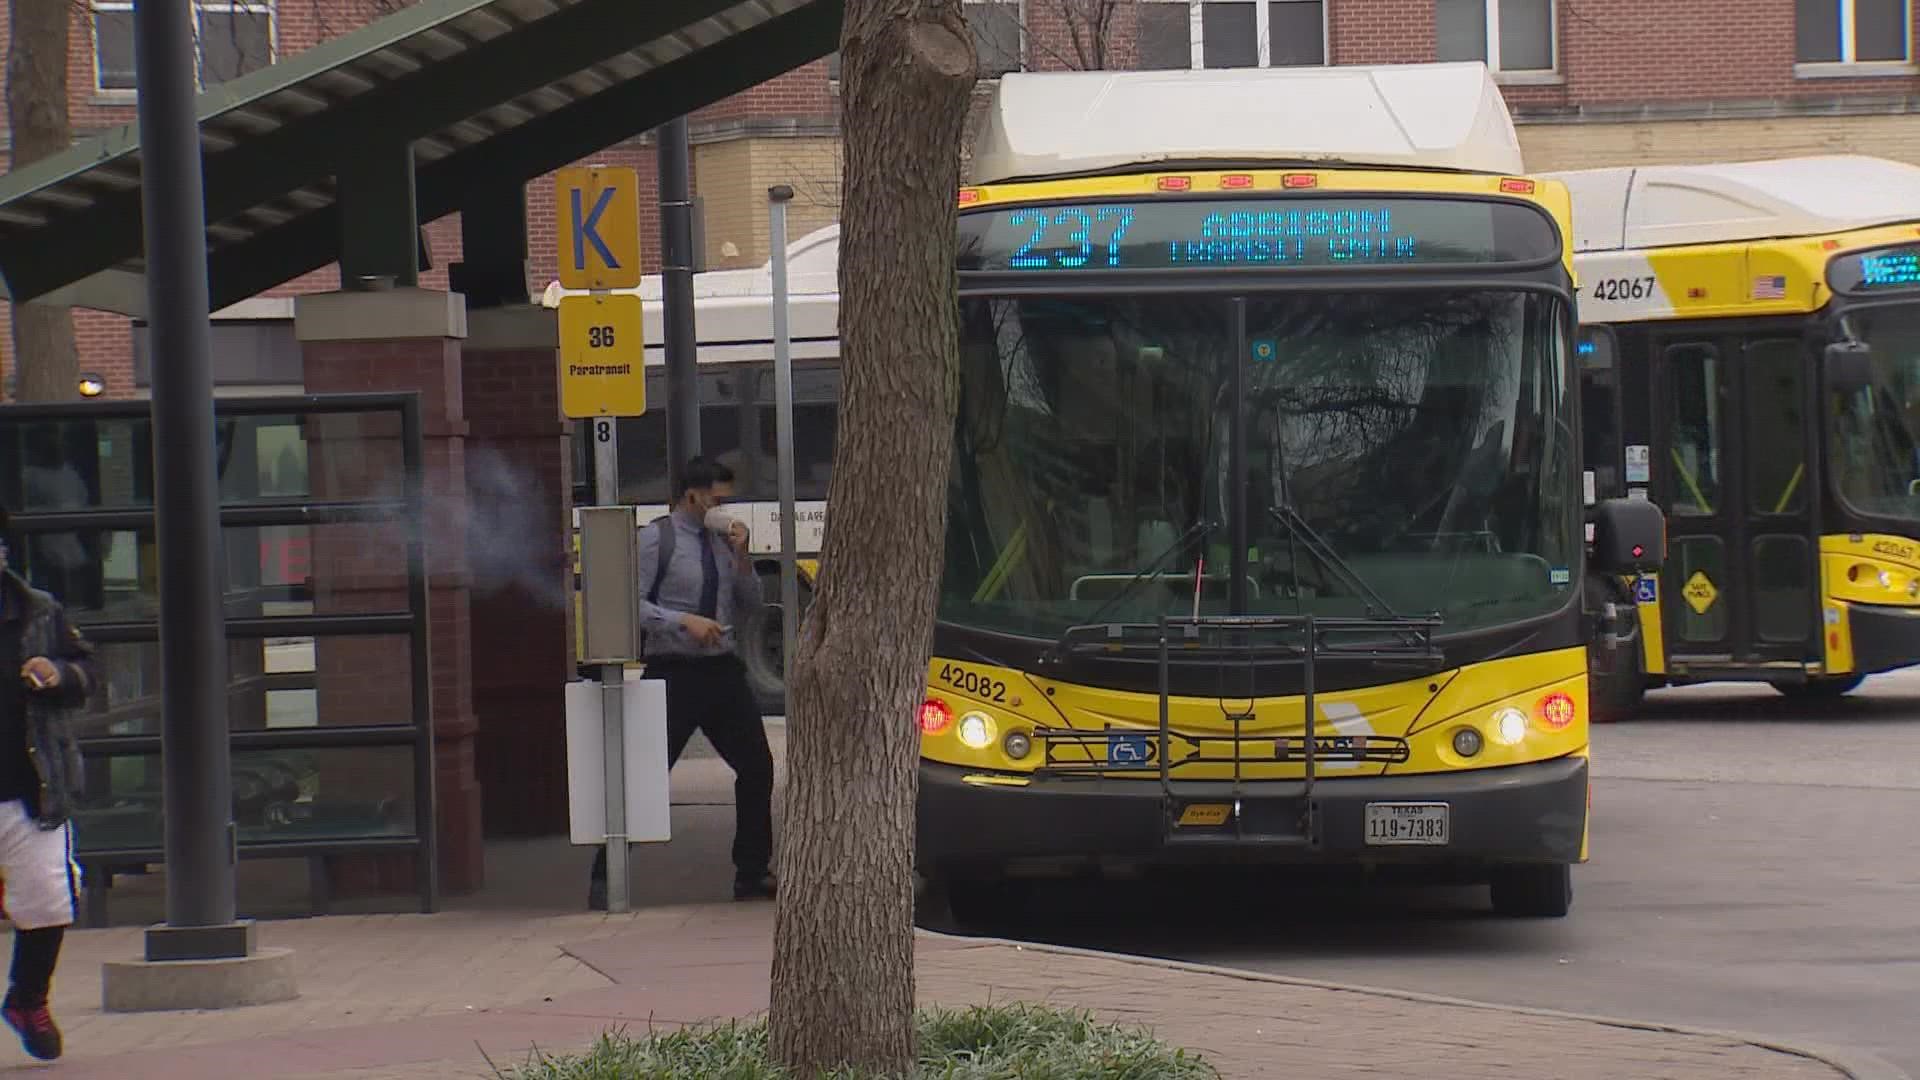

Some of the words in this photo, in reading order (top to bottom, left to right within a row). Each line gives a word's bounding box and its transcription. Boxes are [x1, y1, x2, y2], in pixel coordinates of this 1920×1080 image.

[570, 187, 622, 270] K
[1008, 207, 1135, 267] 237
[1203, 208, 1391, 238] ADDISON
[1168, 238, 1305, 262] TRANSIT
[1594, 277, 1655, 301] 42067
[588, 326, 615, 348] 36
[569, 363, 631, 376] Paratransit
[597, 421, 610, 443] 8
[940, 664, 1006, 703] 42082
[1391, 806, 1424, 815] TEXAS
[1370, 819, 1444, 838] 119-7383
